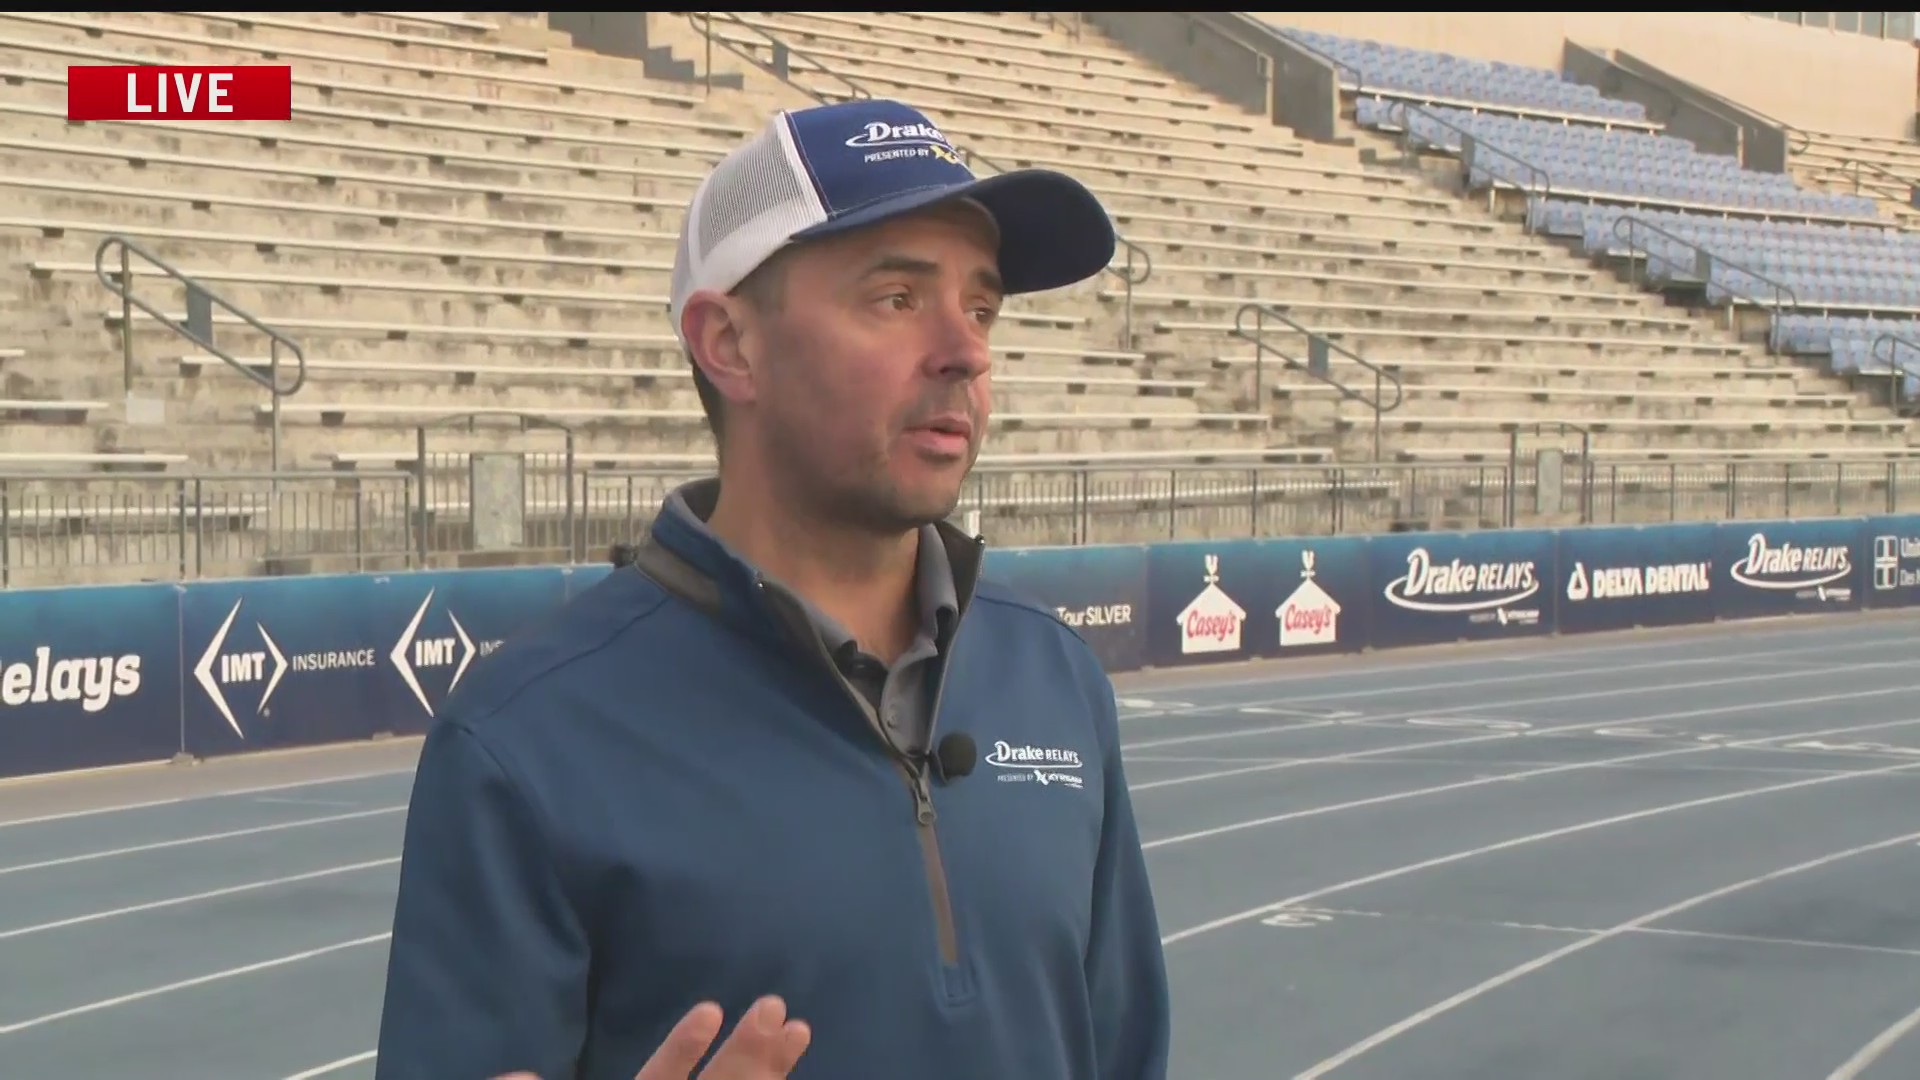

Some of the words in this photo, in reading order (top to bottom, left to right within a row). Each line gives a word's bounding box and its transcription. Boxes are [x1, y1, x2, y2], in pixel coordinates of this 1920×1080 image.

[864, 149, 916, 163] PRESENTED
[1745, 533, 1802, 575] Drake
[1802, 546, 1848, 571] RELAYS
[1404, 548, 1476, 596] Drake
[1476, 561, 1534, 592] RELAYS
[1592, 566, 1643, 599] DELTA
[1645, 562, 1710, 595] DENTAL
[1086, 604, 1132, 626] SILVER
[1187, 609, 1236, 642] Casey's
[1284, 603, 1332, 635] Casey's
[221, 651, 266, 684] IMT
[292, 648, 376, 671] INSURANCE
[414, 637, 456, 667] IMT
[0, 645, 141, 712] elays
[994, 740, 1044, 762] Drake
[1045, 749, 1079, 764] RELAYS
